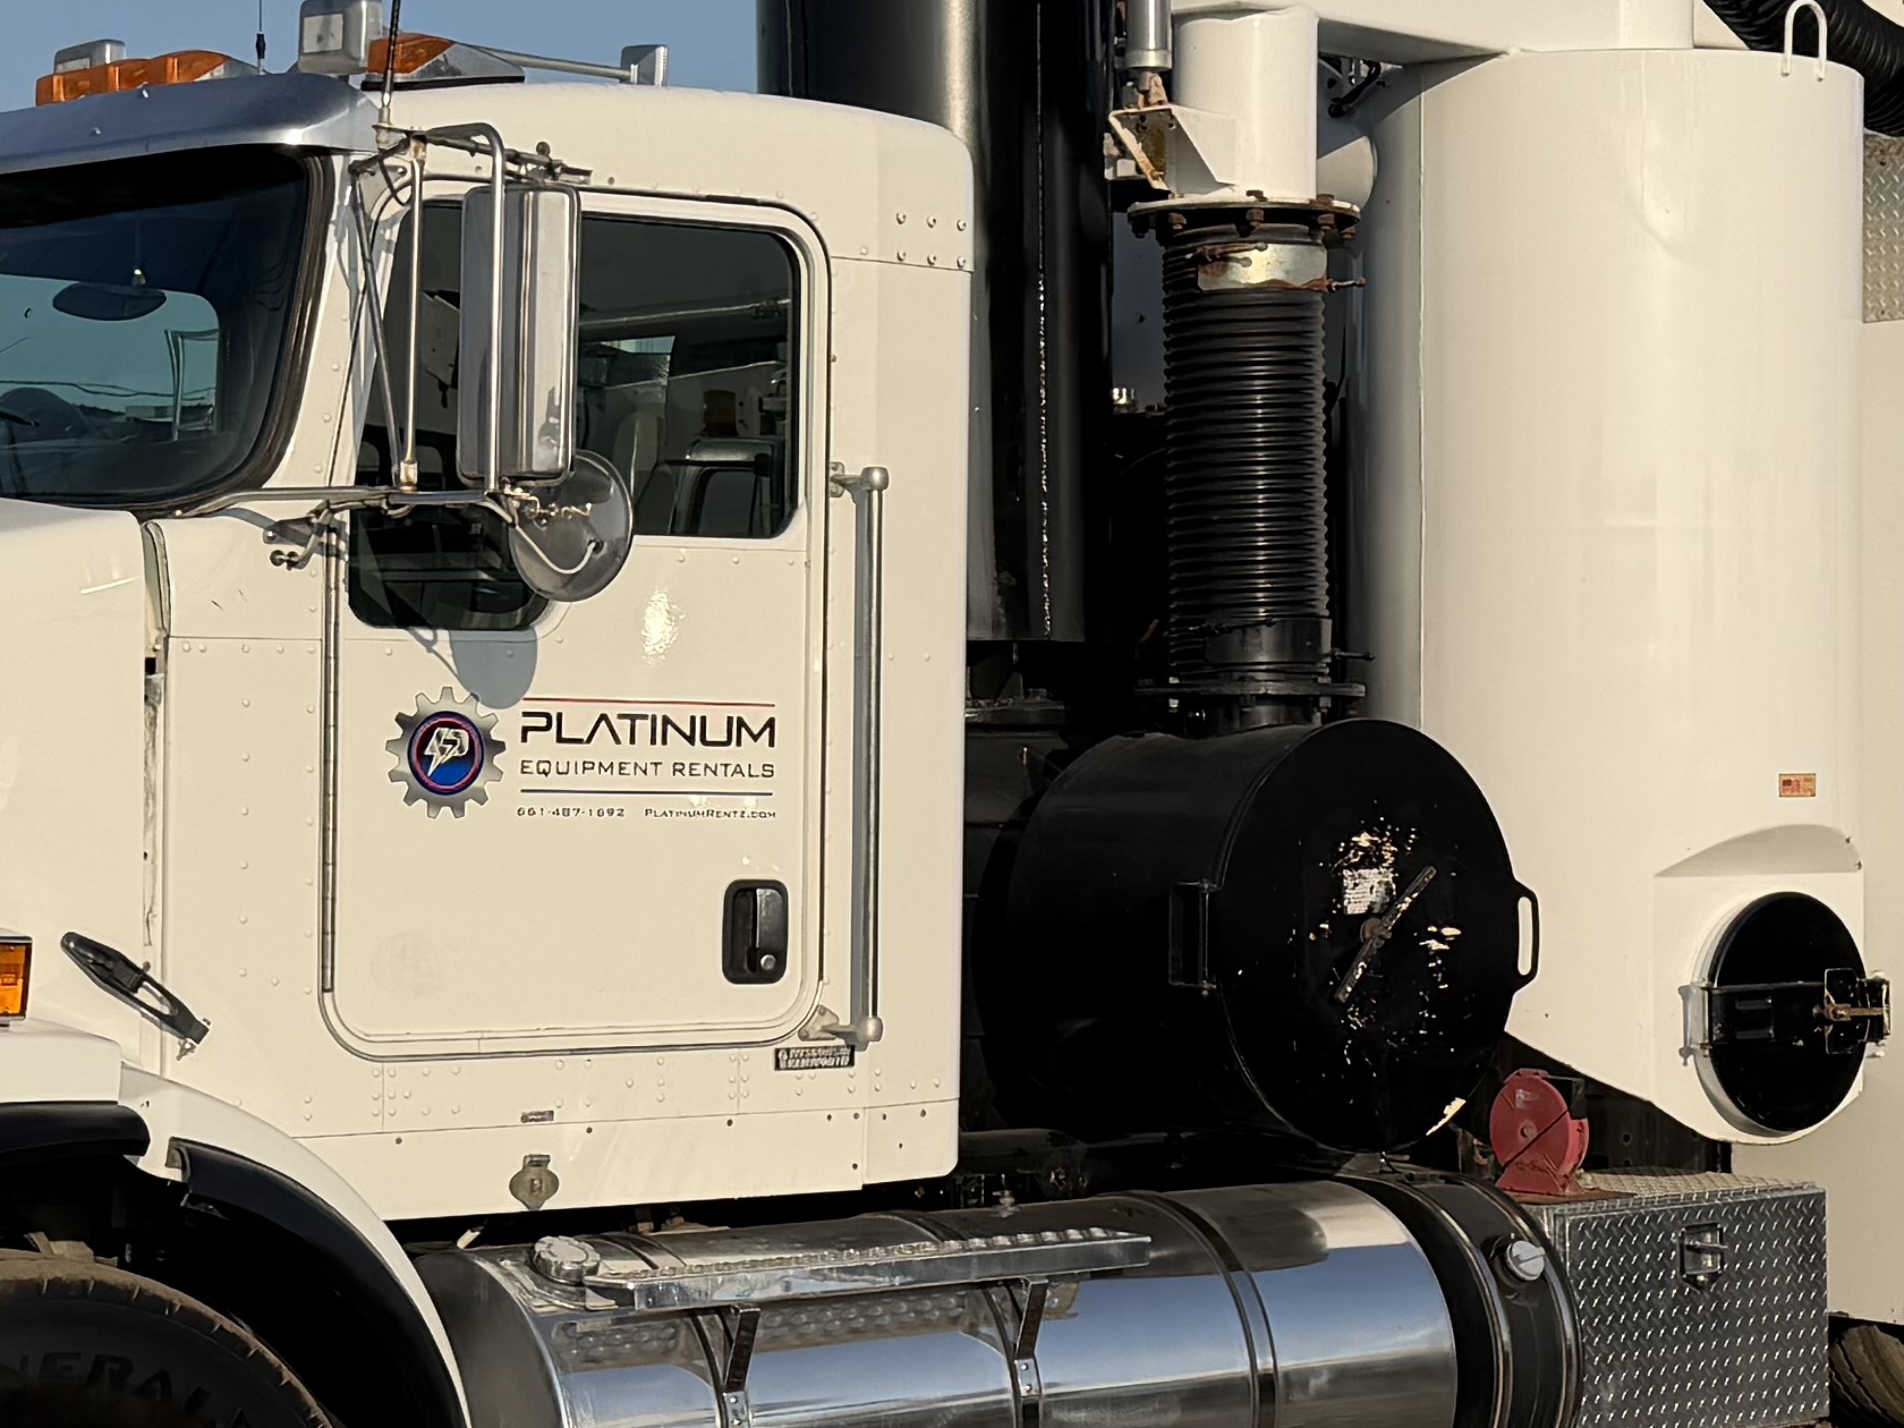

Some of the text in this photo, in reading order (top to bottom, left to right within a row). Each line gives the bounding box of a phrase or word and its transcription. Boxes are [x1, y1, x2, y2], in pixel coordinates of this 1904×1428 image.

[520, 711, 776, 748] PLATINUM
[520, 759, 775, 778] EQUIPMENT RENTALS
